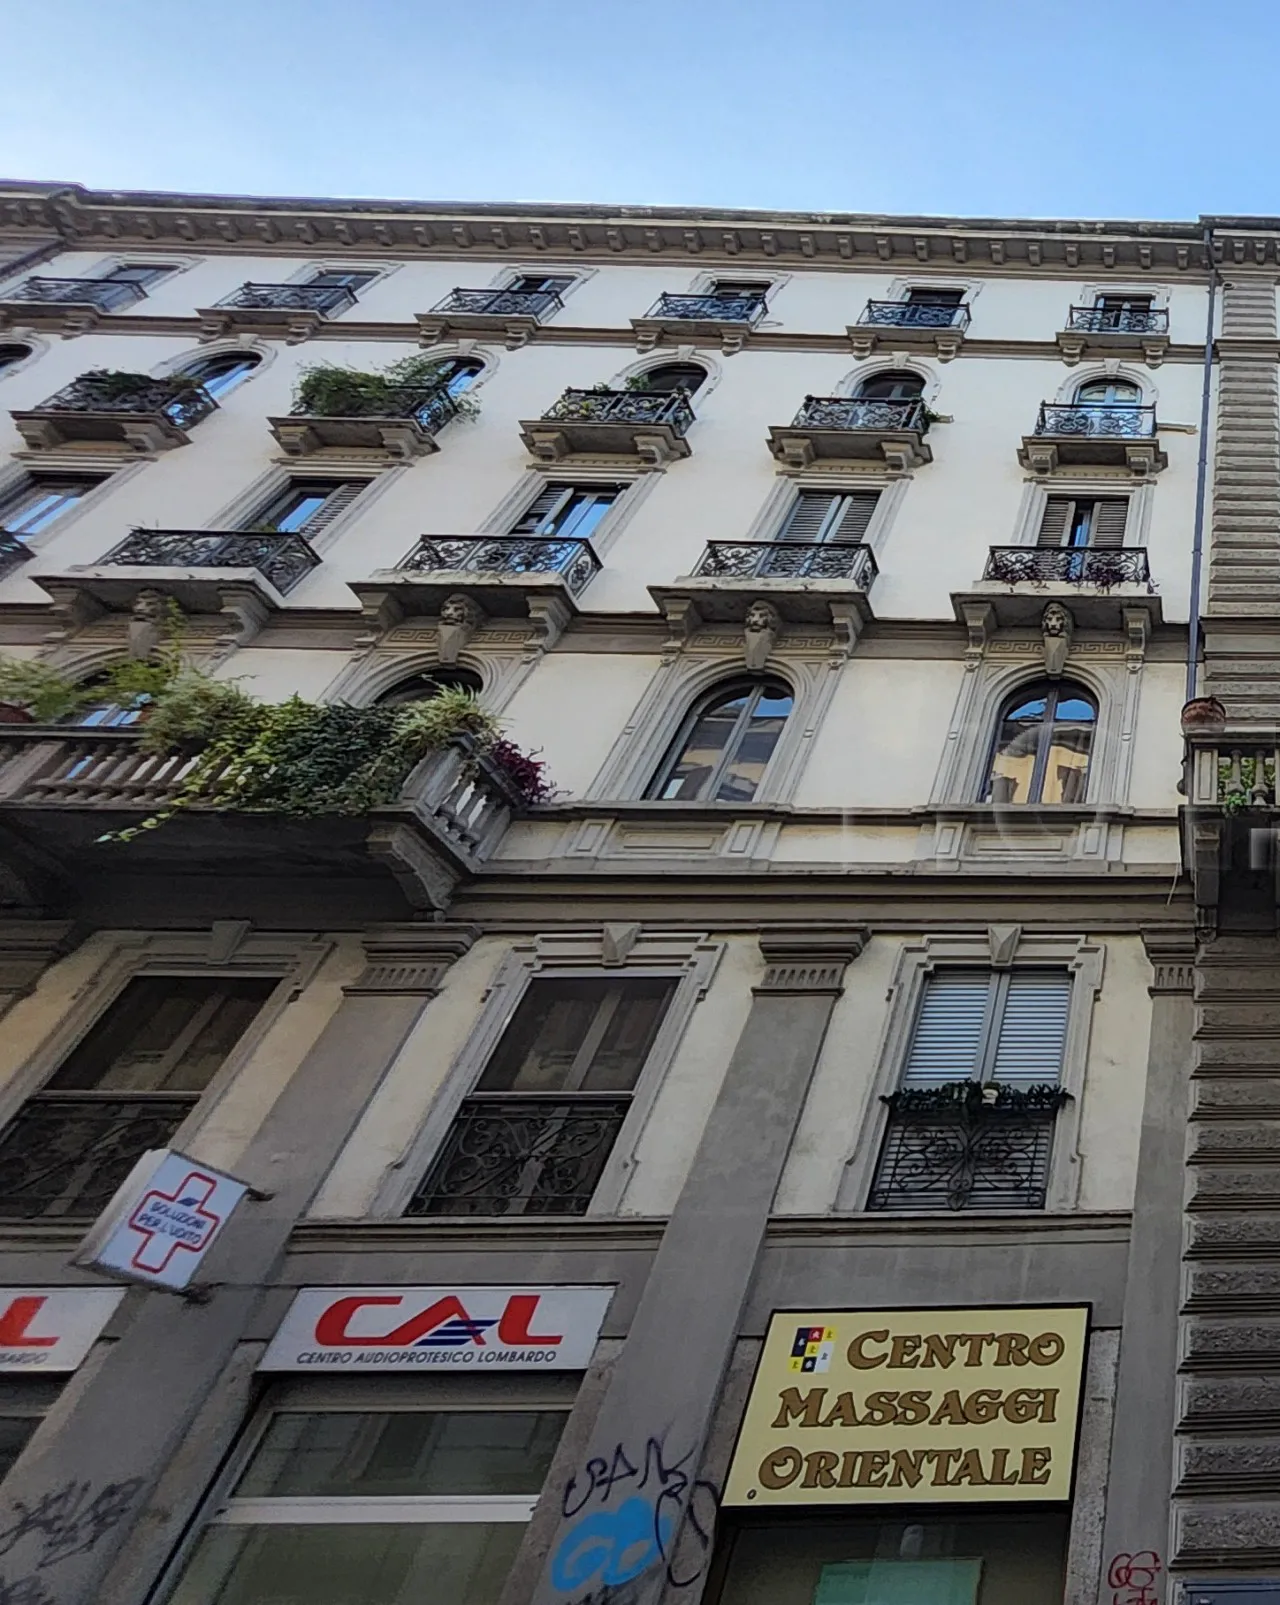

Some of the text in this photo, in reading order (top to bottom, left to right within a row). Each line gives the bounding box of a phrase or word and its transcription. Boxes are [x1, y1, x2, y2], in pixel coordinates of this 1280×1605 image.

[314, 1295, 564, 1347] CAL
[296, 1350, 557, 1364] CENTRO AUDIOPROTESICO LOMBARDO
[847, 1329, 1065, 1370] CENTRO
[770, 1387, 1060, 1429] MASSAGGI
[758, 1446, 1052, 1490] ORIENTALE
